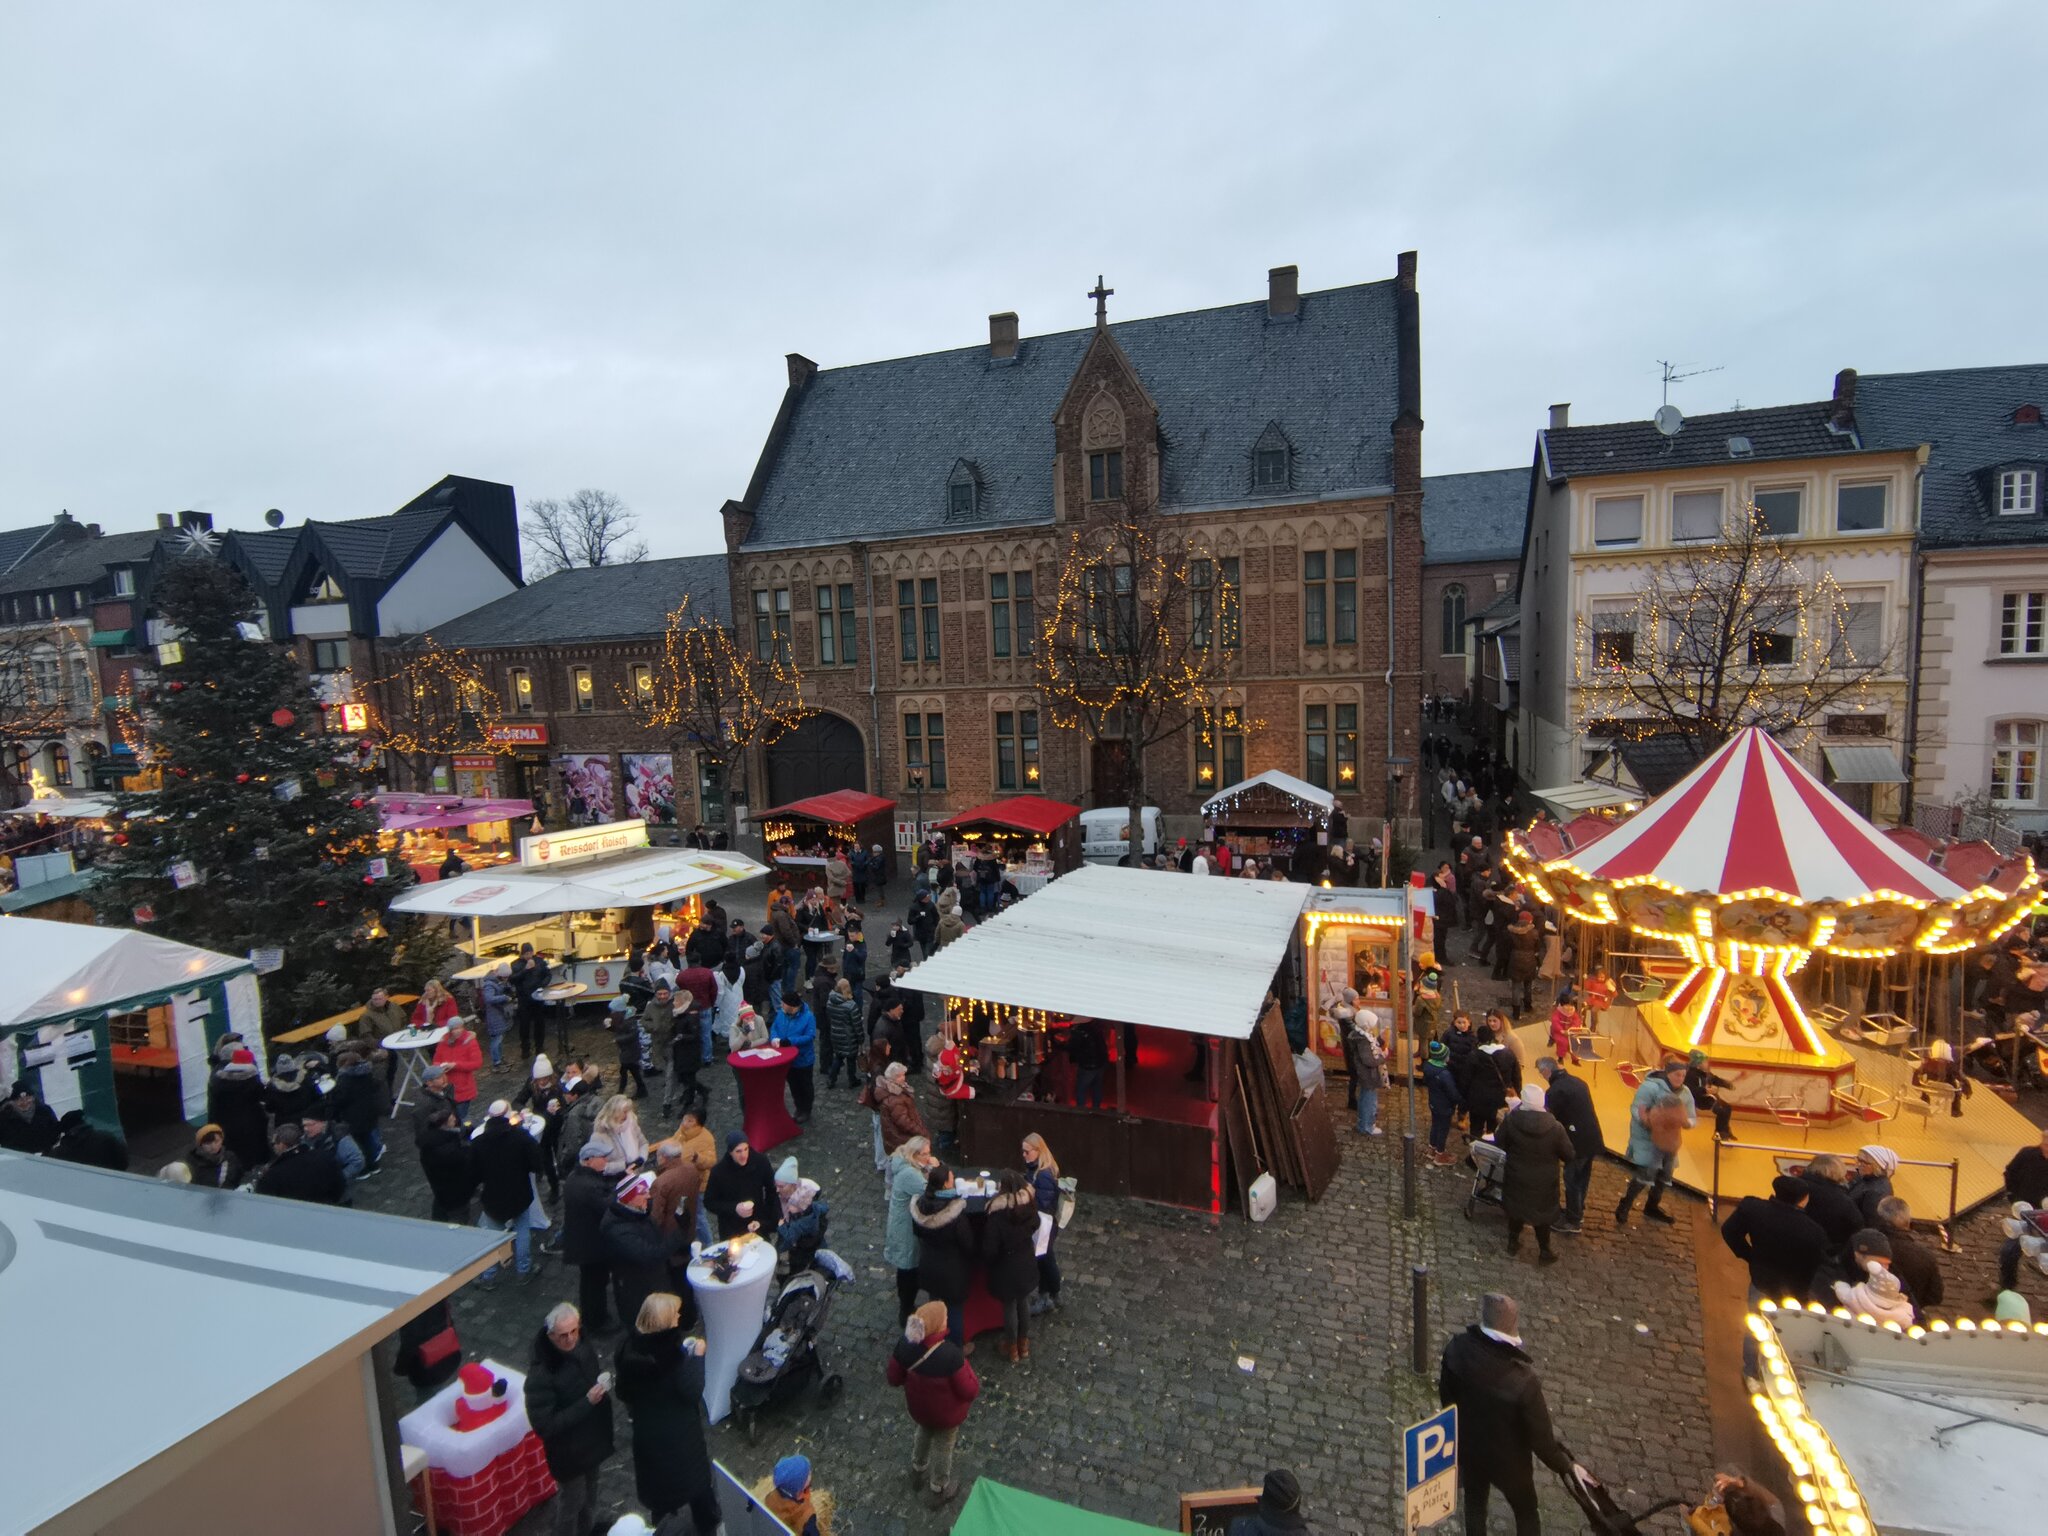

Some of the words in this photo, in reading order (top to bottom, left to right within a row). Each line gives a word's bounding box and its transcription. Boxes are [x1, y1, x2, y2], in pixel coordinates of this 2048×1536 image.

[493, 728, 539, 740] NORMA
[560, 840, 599, 856] Reissdorf
[1417, 1424, 1446, 1483] P
